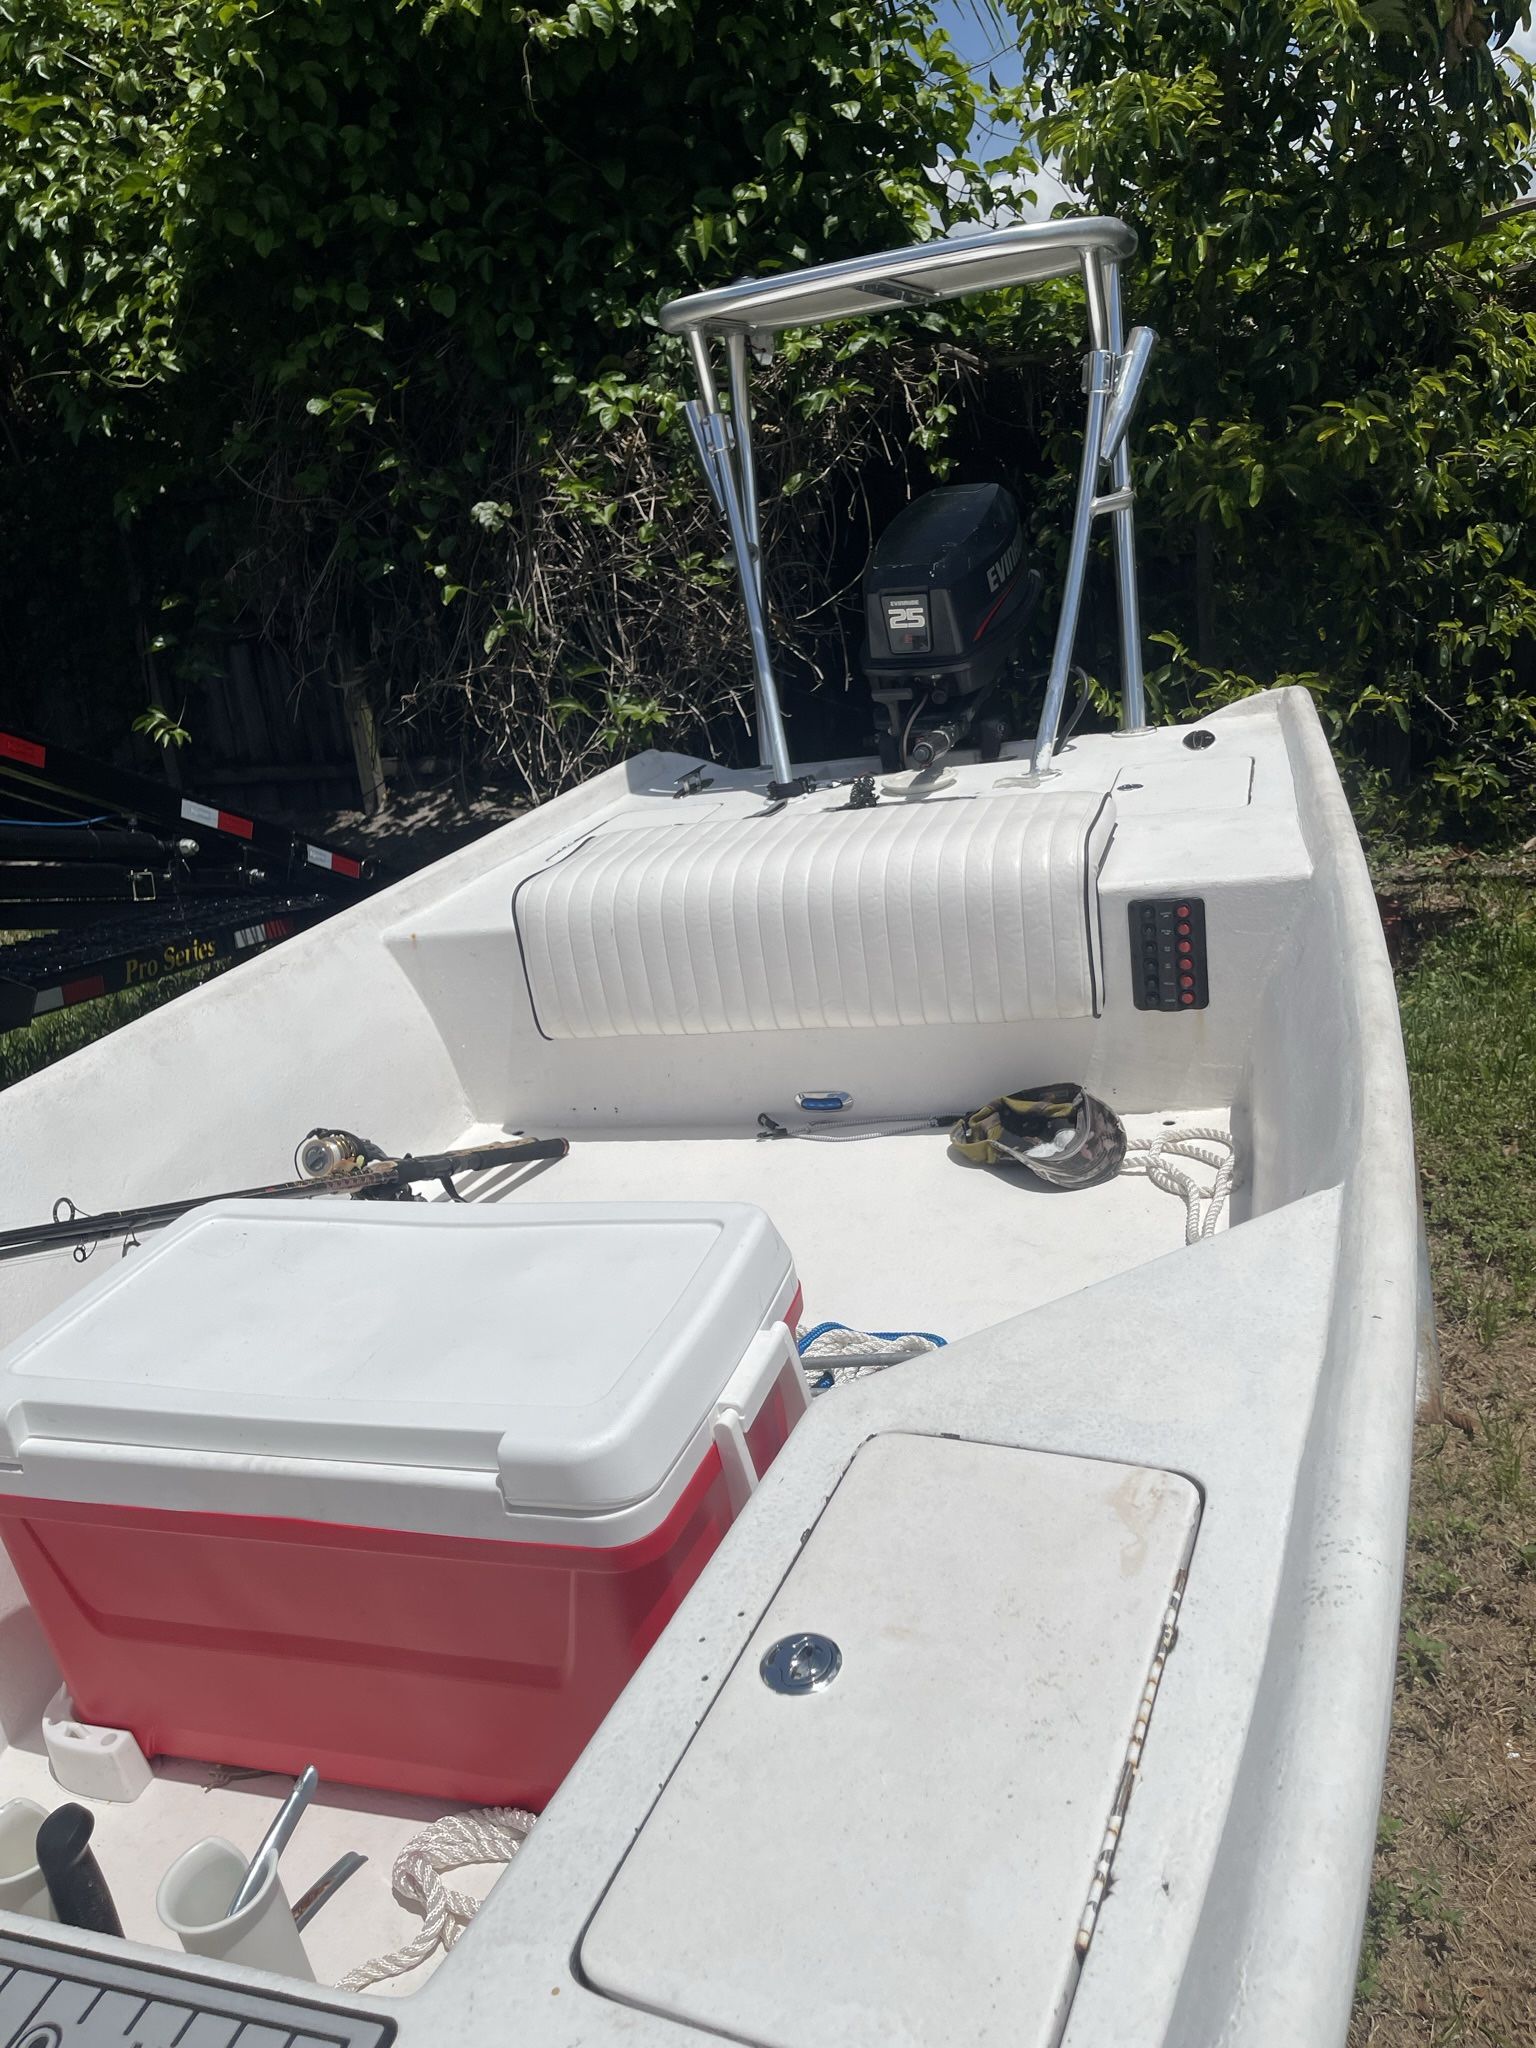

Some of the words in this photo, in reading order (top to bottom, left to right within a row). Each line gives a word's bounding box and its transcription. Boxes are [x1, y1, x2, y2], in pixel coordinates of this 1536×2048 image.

[887, 607, 926, 629] 25
[125, 959, 159, 984] Pro
[163, 938, 216, 972] Series
